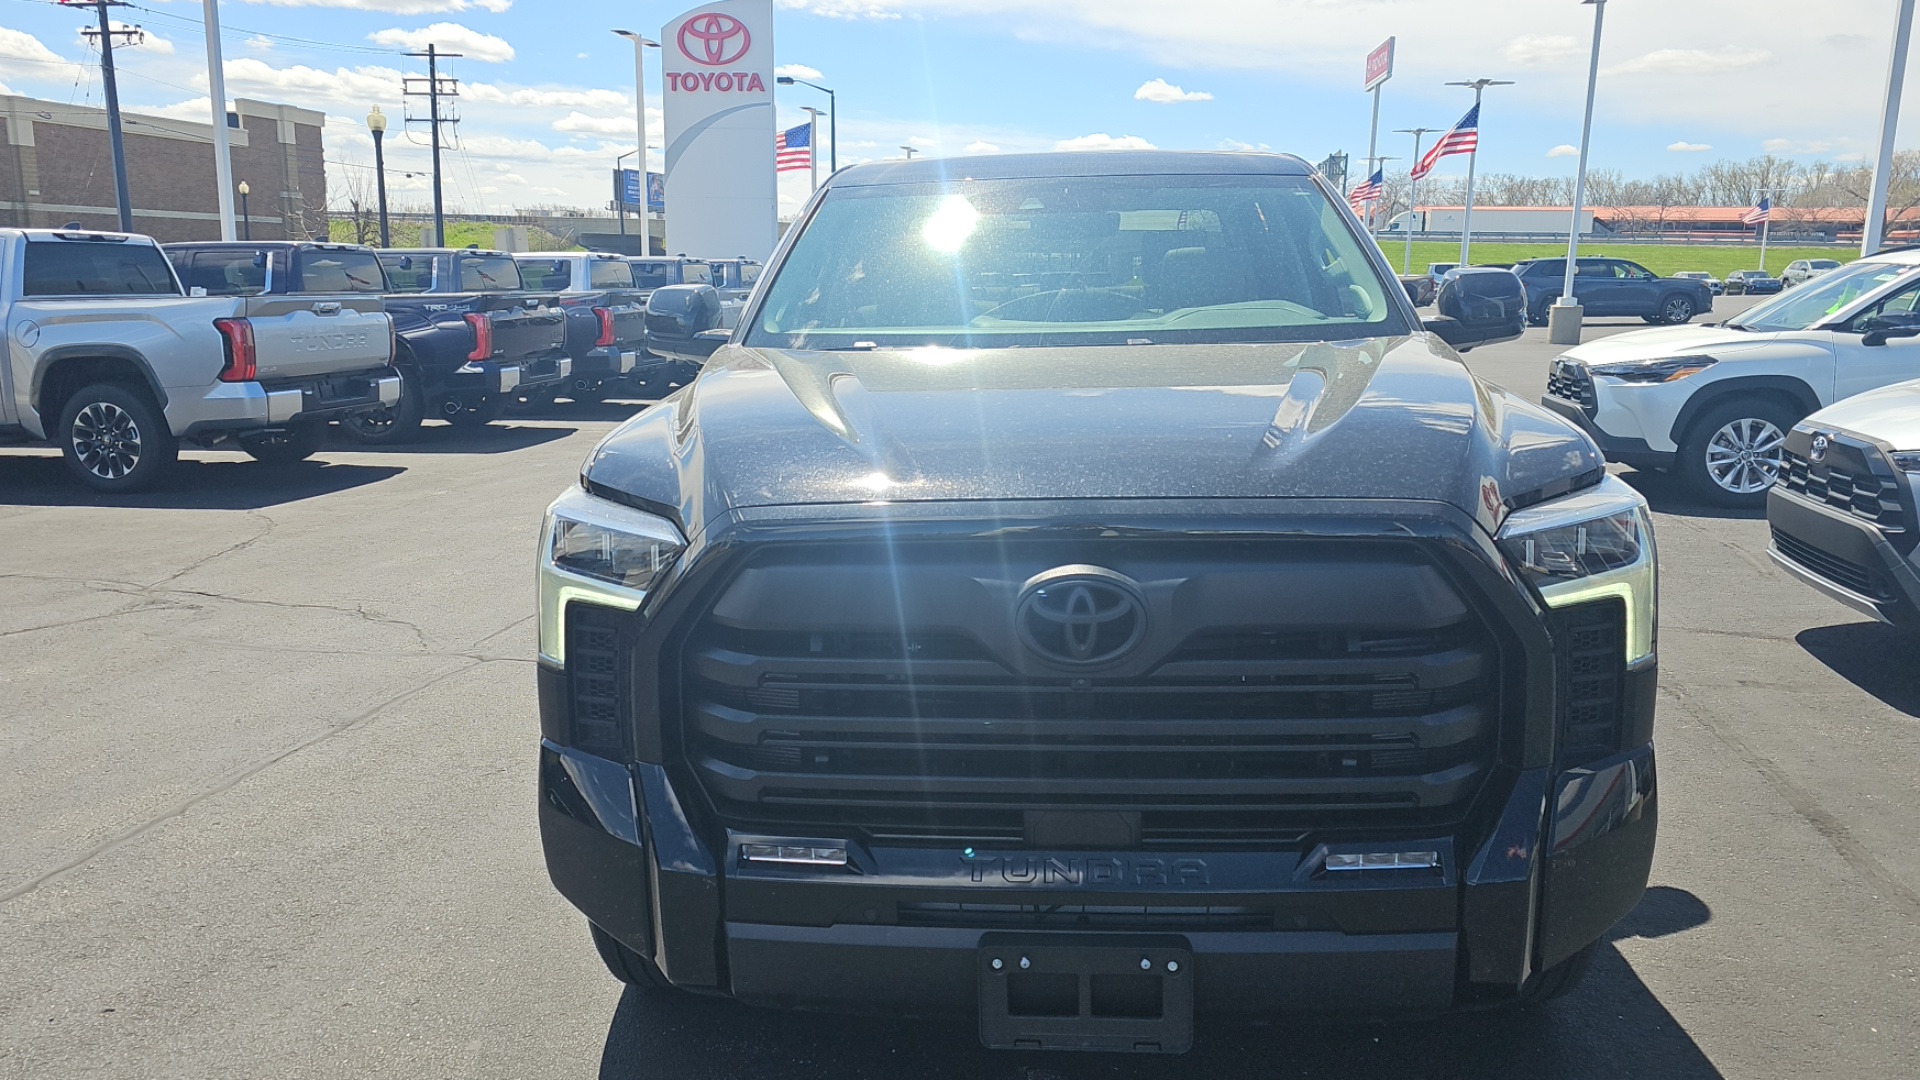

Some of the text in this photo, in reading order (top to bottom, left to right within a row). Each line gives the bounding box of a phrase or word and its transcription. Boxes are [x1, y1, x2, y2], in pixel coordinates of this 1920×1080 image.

[666, 72, 765, 92] TOYOTA
[290, 334, 369, 351] TUNDRA
[959, 856, 1210, 884] TUNDRA
